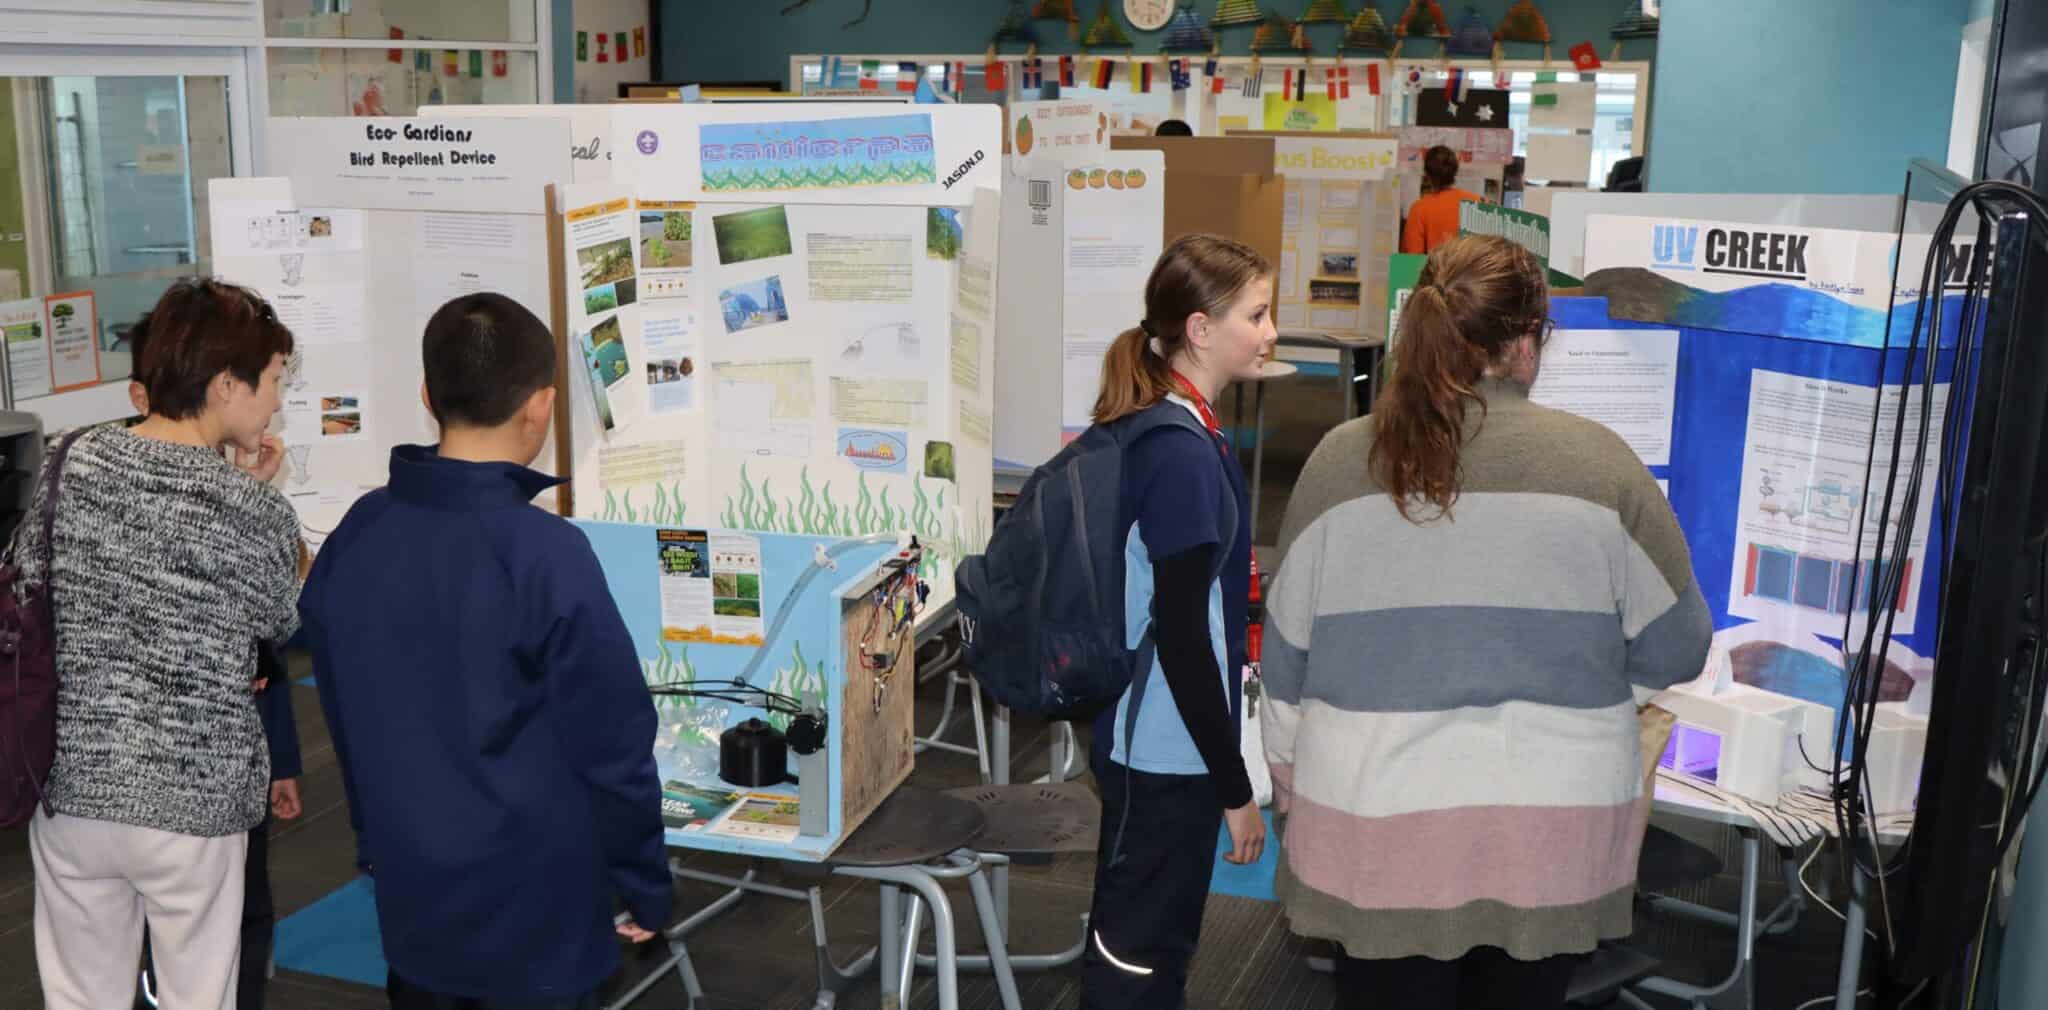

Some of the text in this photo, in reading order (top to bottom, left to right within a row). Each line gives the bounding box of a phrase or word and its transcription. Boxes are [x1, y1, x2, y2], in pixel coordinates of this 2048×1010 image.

[366, 122, 473, 143] Eco- Gardians
[349, 149, 497, 169] Bird Repellent Device
[941, 149, 985, 191] JASON.D
[1312, 145, 1376, 171] Boost
[1653, 224, 1809, 274] UV CREEK
